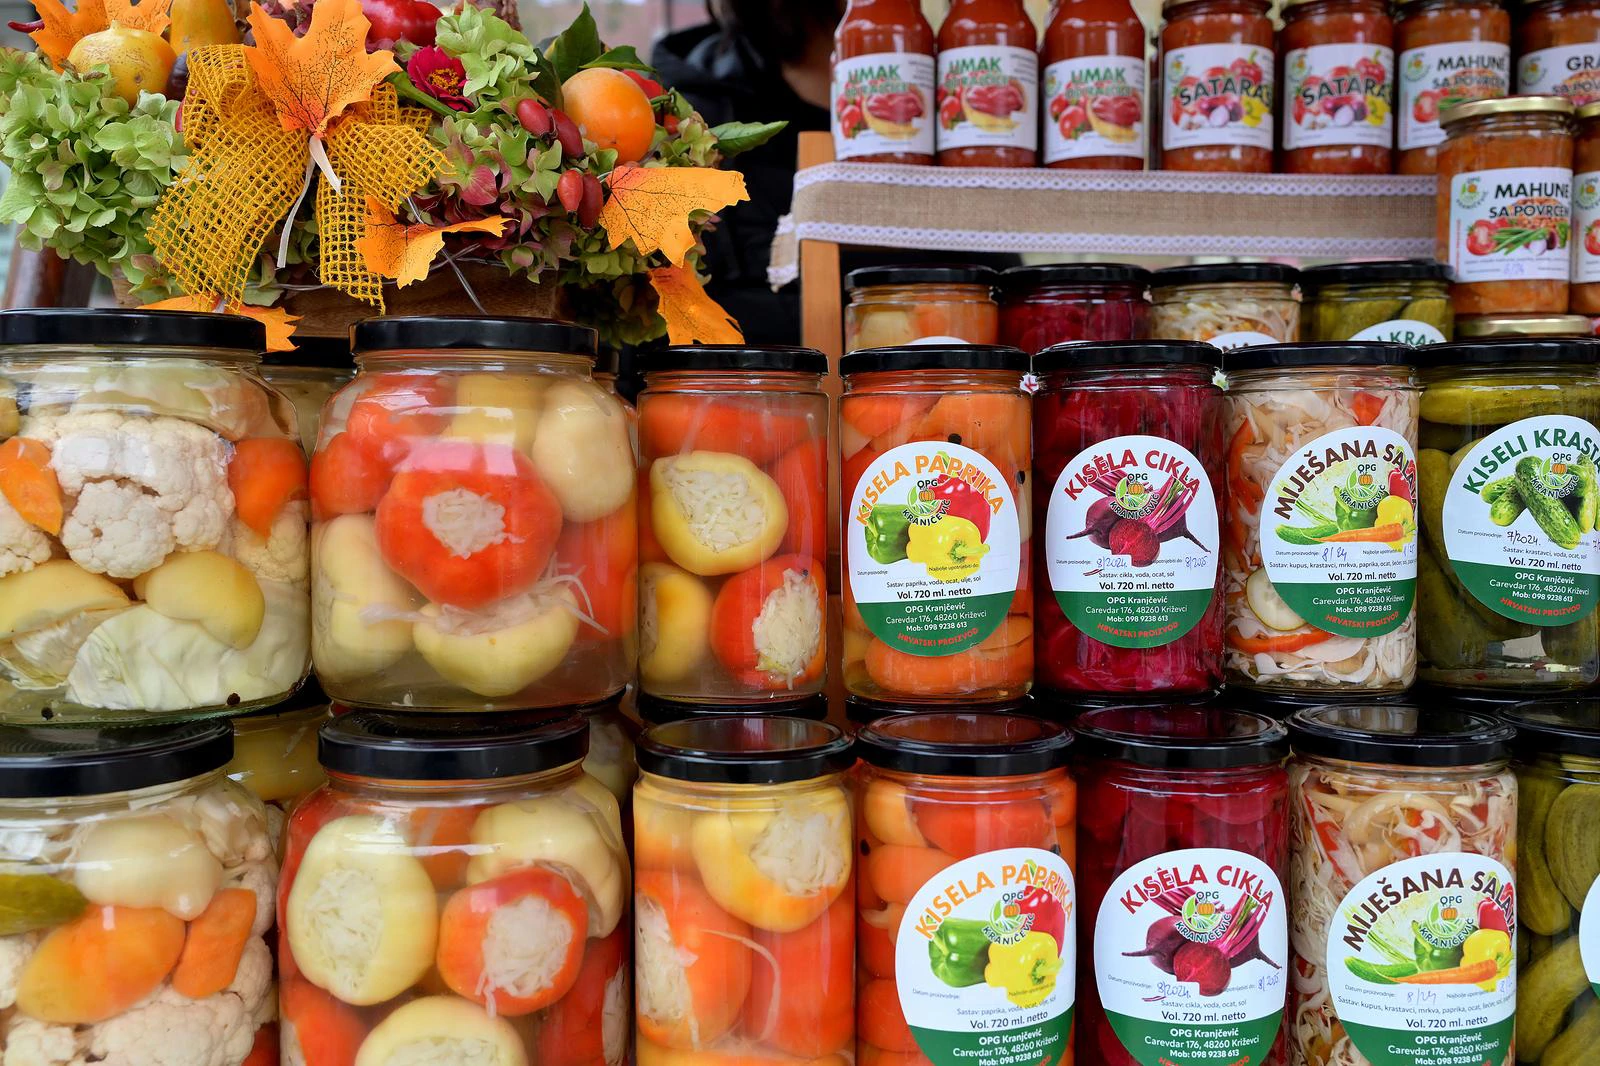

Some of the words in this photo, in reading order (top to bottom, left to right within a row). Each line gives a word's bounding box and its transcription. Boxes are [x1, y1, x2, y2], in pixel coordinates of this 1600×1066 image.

[949, 57, 1002, 73] UMAK
[848, 65, 900, 84] UMAK
[1071, 68, 1125, 82] UMAK
[1495, 183, 1569, 199] MAHUNE
[1489, 207, 1509, 219] SA
[1552, 453, 1571, 461] OPG
[1358, 464, 1376, 473] OPG
[1463, 435, 1529, 495] KISELI
[1064, 449, 1138, 501] KISELA
[1145, 450, 1201, 498] CIKLA
[1127, 473, 1148, 482] OPG
[1274, 439, 1378, 520] MIJEŠANA
[917, 480, 938, 488] OPG
[856, 461, 910, 525] KISELA
[915, 455, 1004, 514] PAPRIKA
[1503, 546, 1524, 554] Sastav:
[1526, 548, 1552, 557] krastavci,
[1509, 557, 1525, 565] Vol.
[1529, 559, 1544, 567] 720
[1547, 561, 1559, 569] ml.
[1328, 573, 1345, 581] Vol.
[1365, 572, 1377, 580] ml.
[1537, 574, 1574, 584] Kranjčević
[905, 579, 928, 588] paprika,
[1099, 582, 1115, 590] Vol.
[1118, 582, 1133, 590] 720
[1136, 581, 1150, 590] ml.
[1490, 580, 1526, 589] Carevdar
[1528, 584, 1542, 592] 176,
[897, 591, 913, 599] Vol.
[914, 590, 930, 598] 720
[933, 589, 946, 597] ml.
[948, 588, 971, 596] netto
[1357, 587, 1391, 595] Kranjčević
[1512, 591, 1530, 599] Mob:
[1128, 596, 1168, 605] Kranjčević
[905, 605, 923, 613] OPG
[926, 602, 965, 613] Kranjčević
[1136, 606, 1159, 614] 48260
[886, 616, 917, 624] Carevdar
[919, 615, 933, 623] 176,
[935, 613, 957, 622] 48260
[960, 611, 987, 619] Križevci
[906, 624, 923, 632] Mob:
[1120, 864, 1208, 915] KISELA
[1216, 865, 1273, 913] CIKLA
[1002, 891, 1024, 902] OPG
[1196, 891, 1219, 900] OPG
[1440, 895, 1462, 905] OPG
[915, 871, 995, 939] KISELA
[1002, 864, 1073, 922] PAPRIKA
[1343, 868, 1464, 952] MIJEŠANA
[1361, 1000, 1383, 1011] kupus,
[1385, 1005, 1416, 1014] krastavci,
[1442, 1006, 1466, 1014] paprika,
[970, 1020, 989, 1029] Vol.
[991, 1019, 1008, 1028] 720
[1011, 1017, 1024, 1025] ml.
[1027, 1011, 1048, 1022] netto
[1162, 1011, 1180, 1021] Vol.
[1183, 1012, 1200, 1021] 720
[1205, 1013, 1219, 1021] ml.
[1222, 1012, 1246, 1020] netto
[1406, 1019, 1426, 1028] Vol.
[1428, 1019, 1446, 1028] 720
[1450, 1019, 1464, 1027] ml.
[1466, 1016, 1488, 1026] netto
[979, 1036, 1000, 1045] OPG
[1002, 1029, 1042, 1043] Kranjčević
[1170, 1029, 1192, 1038] OPG
[1194, 1028, 1238, 1038] Kranjčević
[1415, 1036, 1437, 1044] OPG
[1440, 1032, 1482, 1044] Kranjčević
[1145, 1036, 1184, 1048] Carevdar
[1186, 1040, 1201, 1049] 176,
[1204, 1039, 1229, 1048] 48260
[1232, 1035, 1260, 1047] Križevci
[953, 1048, 993, 1057] Carevdar
[1011, 1041, 1034, 1052] 48260
[1207, 1050, 1226, 1058] 9238
[1388, 1045, 1429, 1056] Carevdar
[1432, 1047, 1447, 1056] 176,
[1448, 1045, 1474, 1055] 48260
[979, 1058, 998, 1066] Mob:
[1000, 1056, 1015, 1065] 098
[1016, 1053, 1031, 1062] 9238
[1415, 1057, 1436, 1066] Mob:
[1437, 1057, 1452, 1065] 098
[1453, 1055, 1470, 1064] 9238
